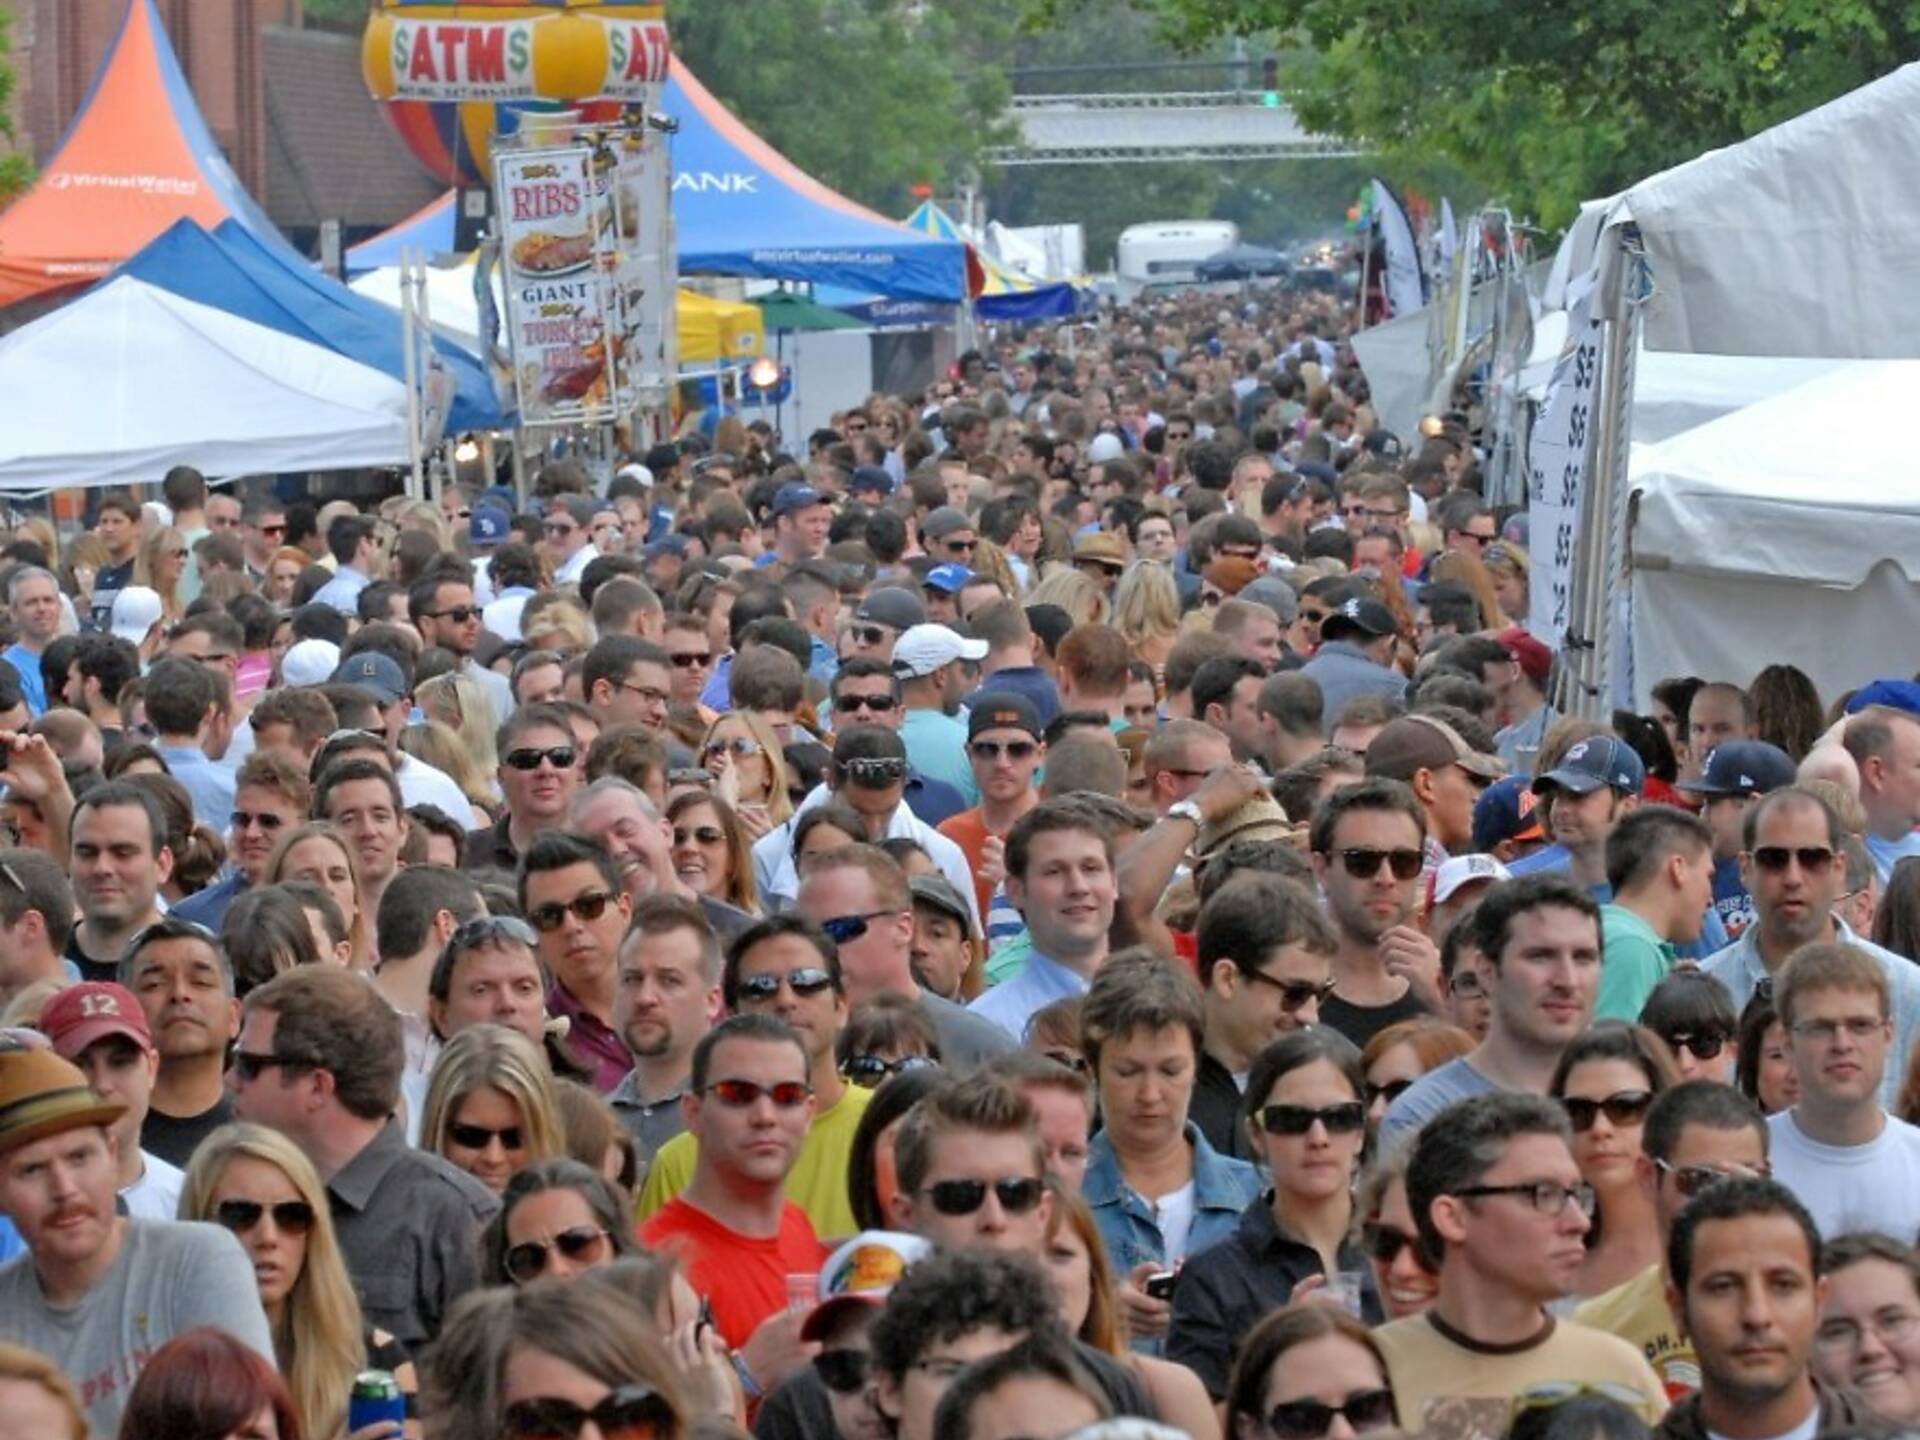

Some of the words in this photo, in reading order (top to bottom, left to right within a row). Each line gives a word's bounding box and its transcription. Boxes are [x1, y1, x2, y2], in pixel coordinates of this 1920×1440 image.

[511, 182, 581, 223] RIBS
[522, 283, 589, 304] GIANT
[80, 993, 121, 1018] 12
